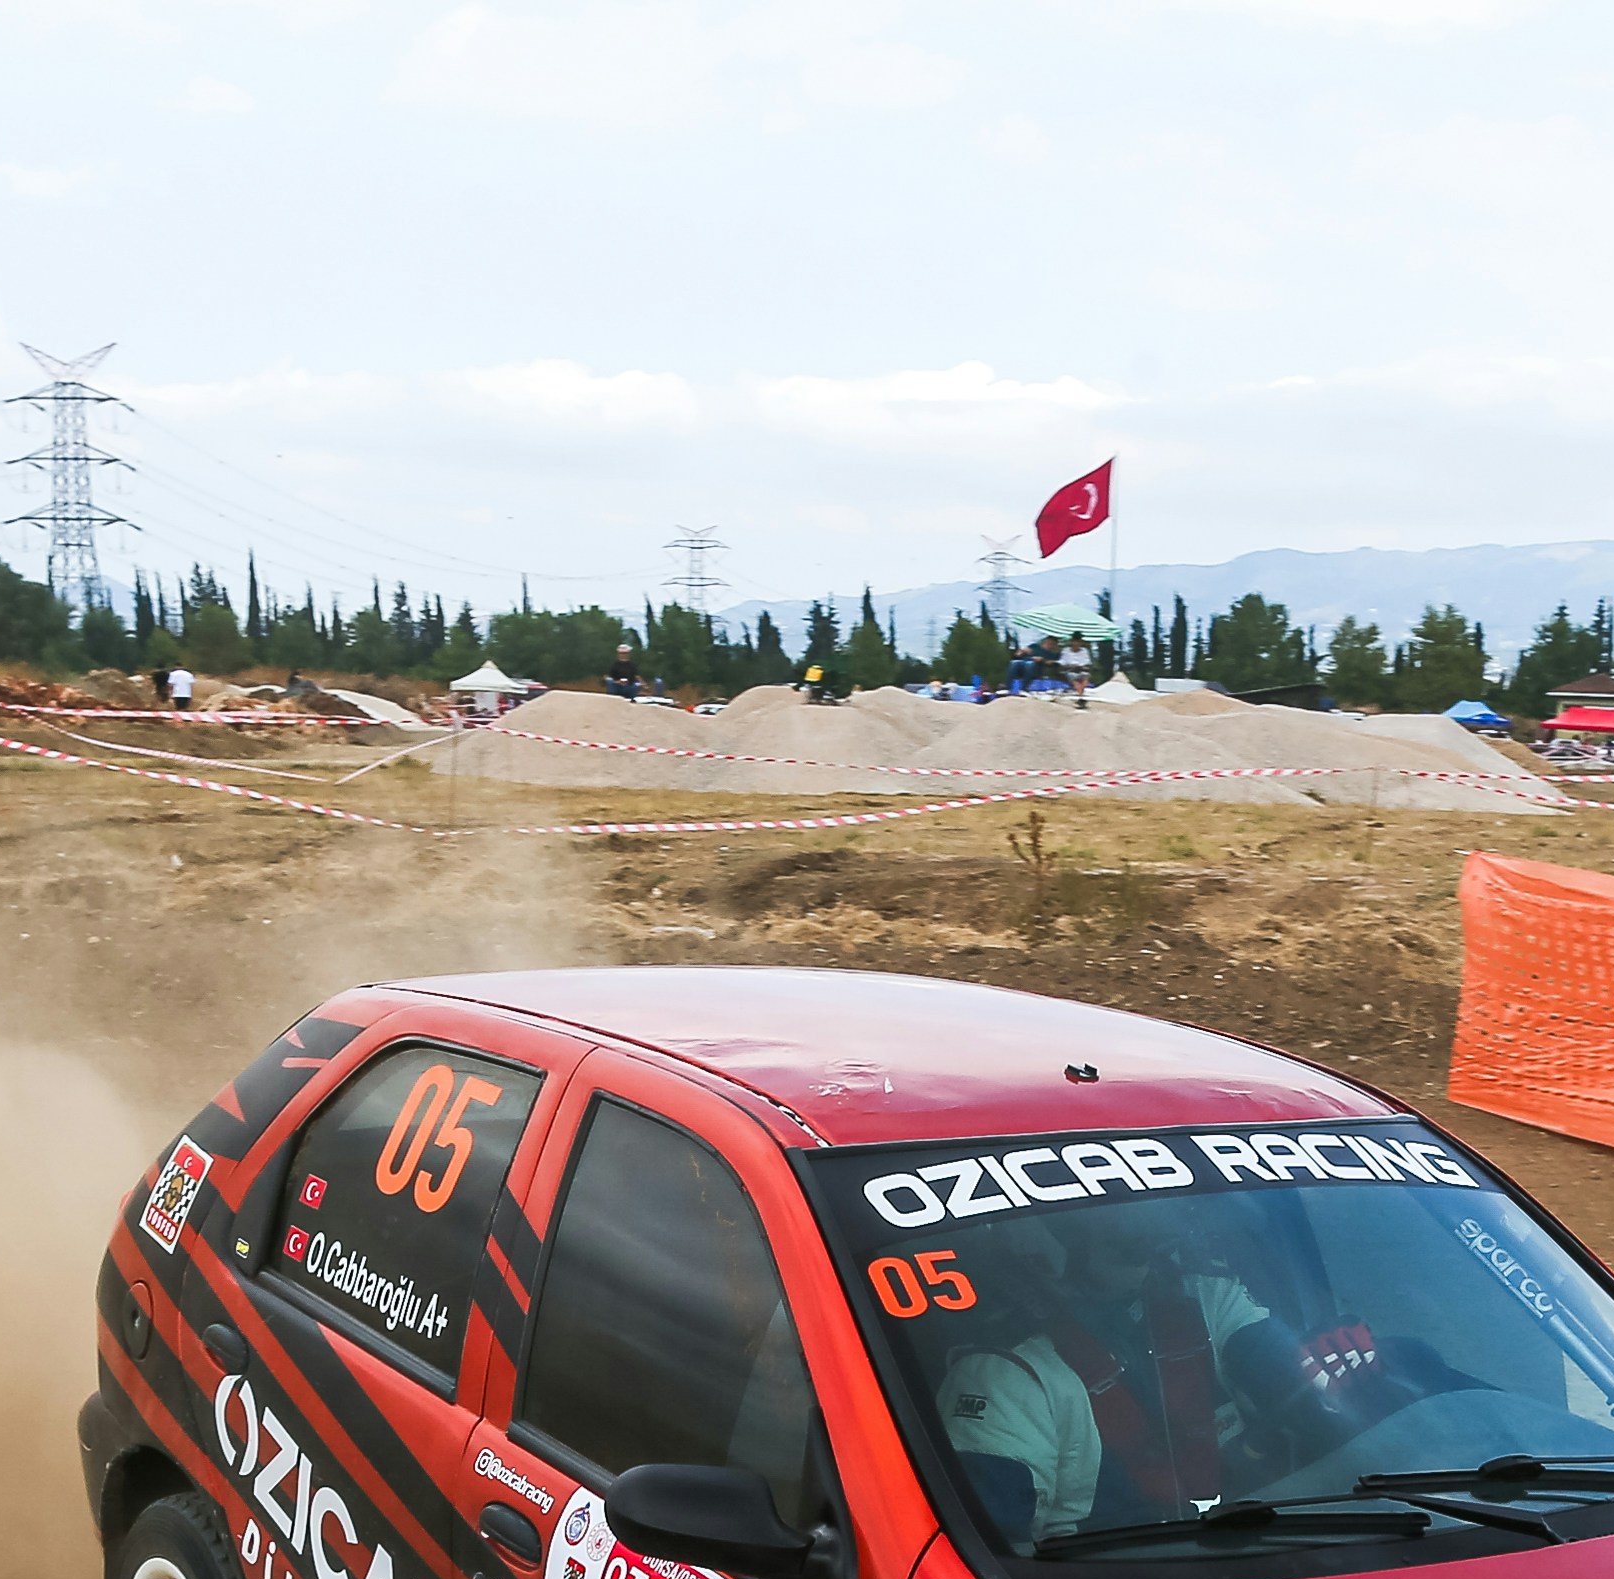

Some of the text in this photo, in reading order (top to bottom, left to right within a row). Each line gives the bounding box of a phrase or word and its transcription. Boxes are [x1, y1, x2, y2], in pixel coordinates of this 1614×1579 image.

[376, 1064, 503, 1213] 05
[863, 1134, 1479, 1228] OZICAB RACING
[306, 1232, 449, 1338] O.Cabbaroğlu A+
[867, 1250, 977, 1318] 05
[1459, 1218, 1554, 1312] sparco
[488, 1458, 554, 1514] @ozicabracing
